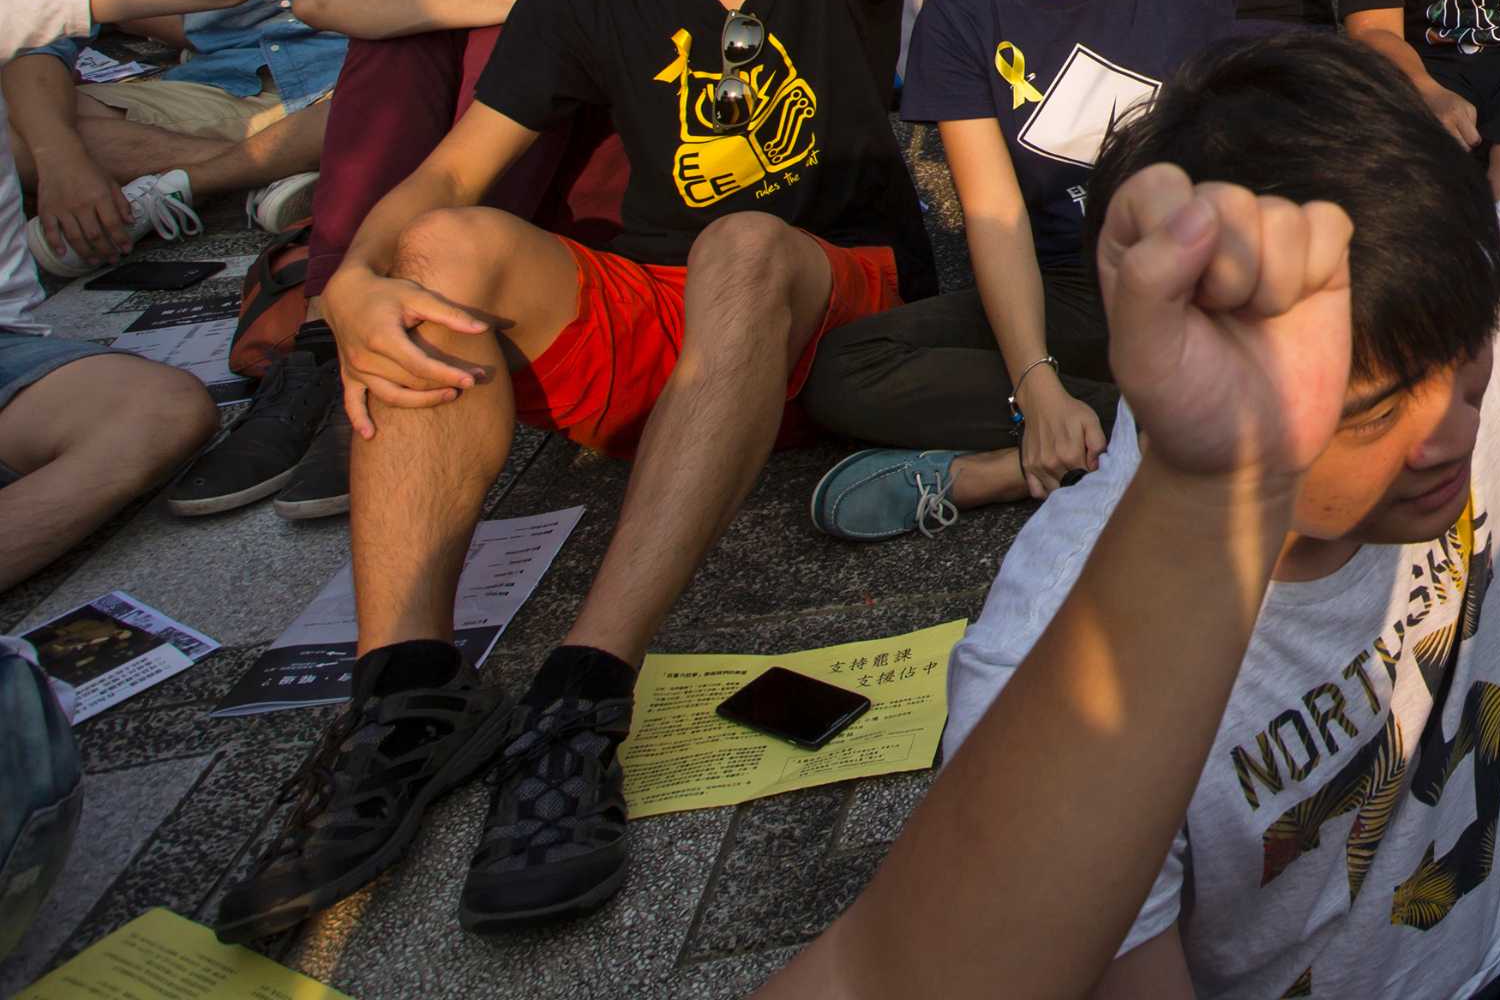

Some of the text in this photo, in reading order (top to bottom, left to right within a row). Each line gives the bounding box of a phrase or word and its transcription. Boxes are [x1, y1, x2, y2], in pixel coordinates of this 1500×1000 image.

[755, 180, 780, 199] rules
[784, 171, 801, 187] the
[829, 648, 913, 674] 支持罷課
[856, 661, 939, 688] 支援佔中
